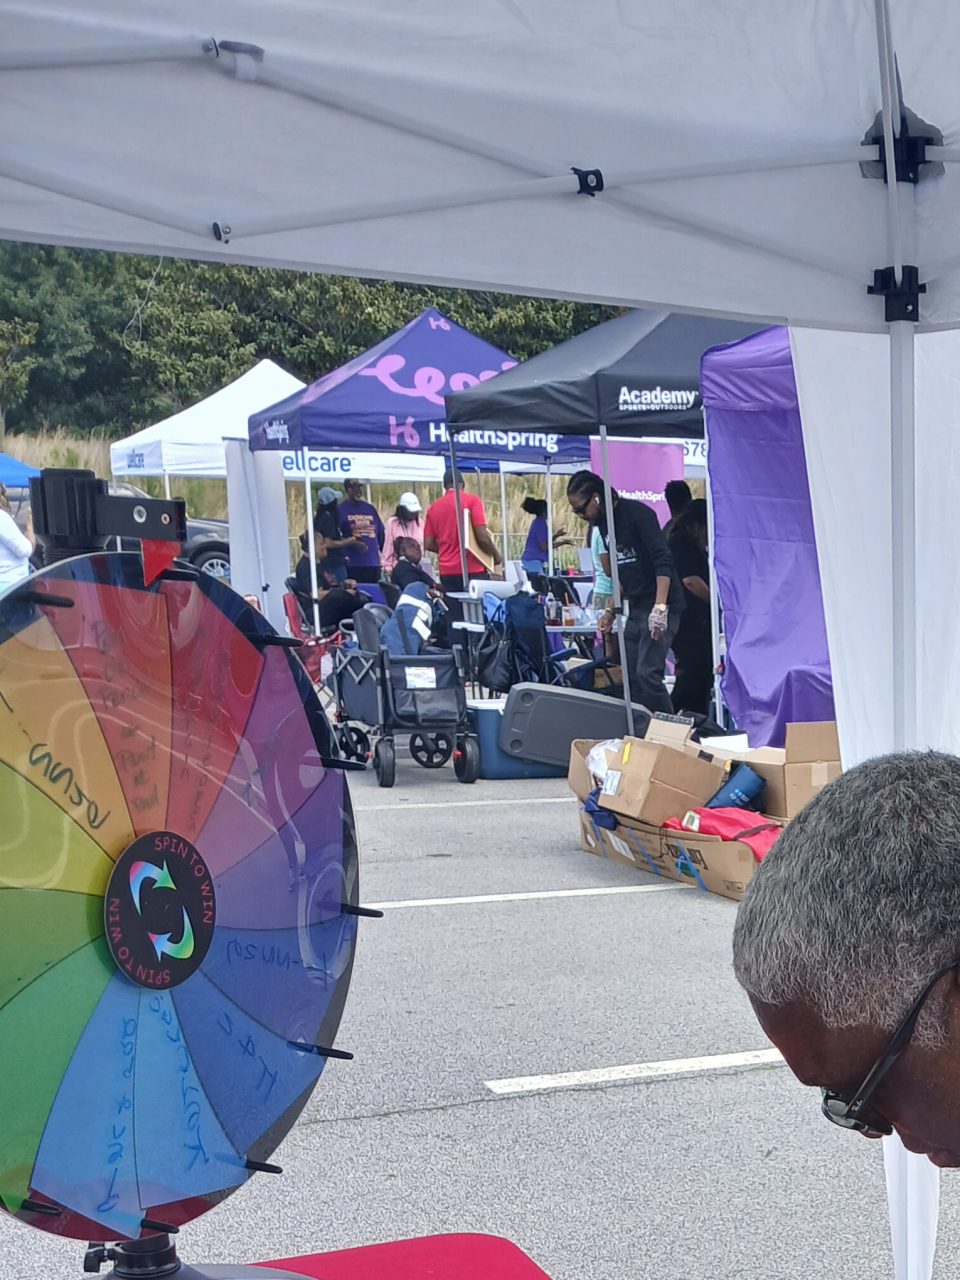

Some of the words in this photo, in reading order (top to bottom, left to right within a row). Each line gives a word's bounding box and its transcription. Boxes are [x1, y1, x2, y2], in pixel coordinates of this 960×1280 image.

[619, 386, 696, 408] Academy
[155, 837, 189, 859] SPIN
[190, 855, 204, 877] TO
[200, 881, 213, 924] WIN
[110, 898, 122, 943] WIN
[119, 947, 132, 970] TO
[136, 966, 170, 985] SPIN
